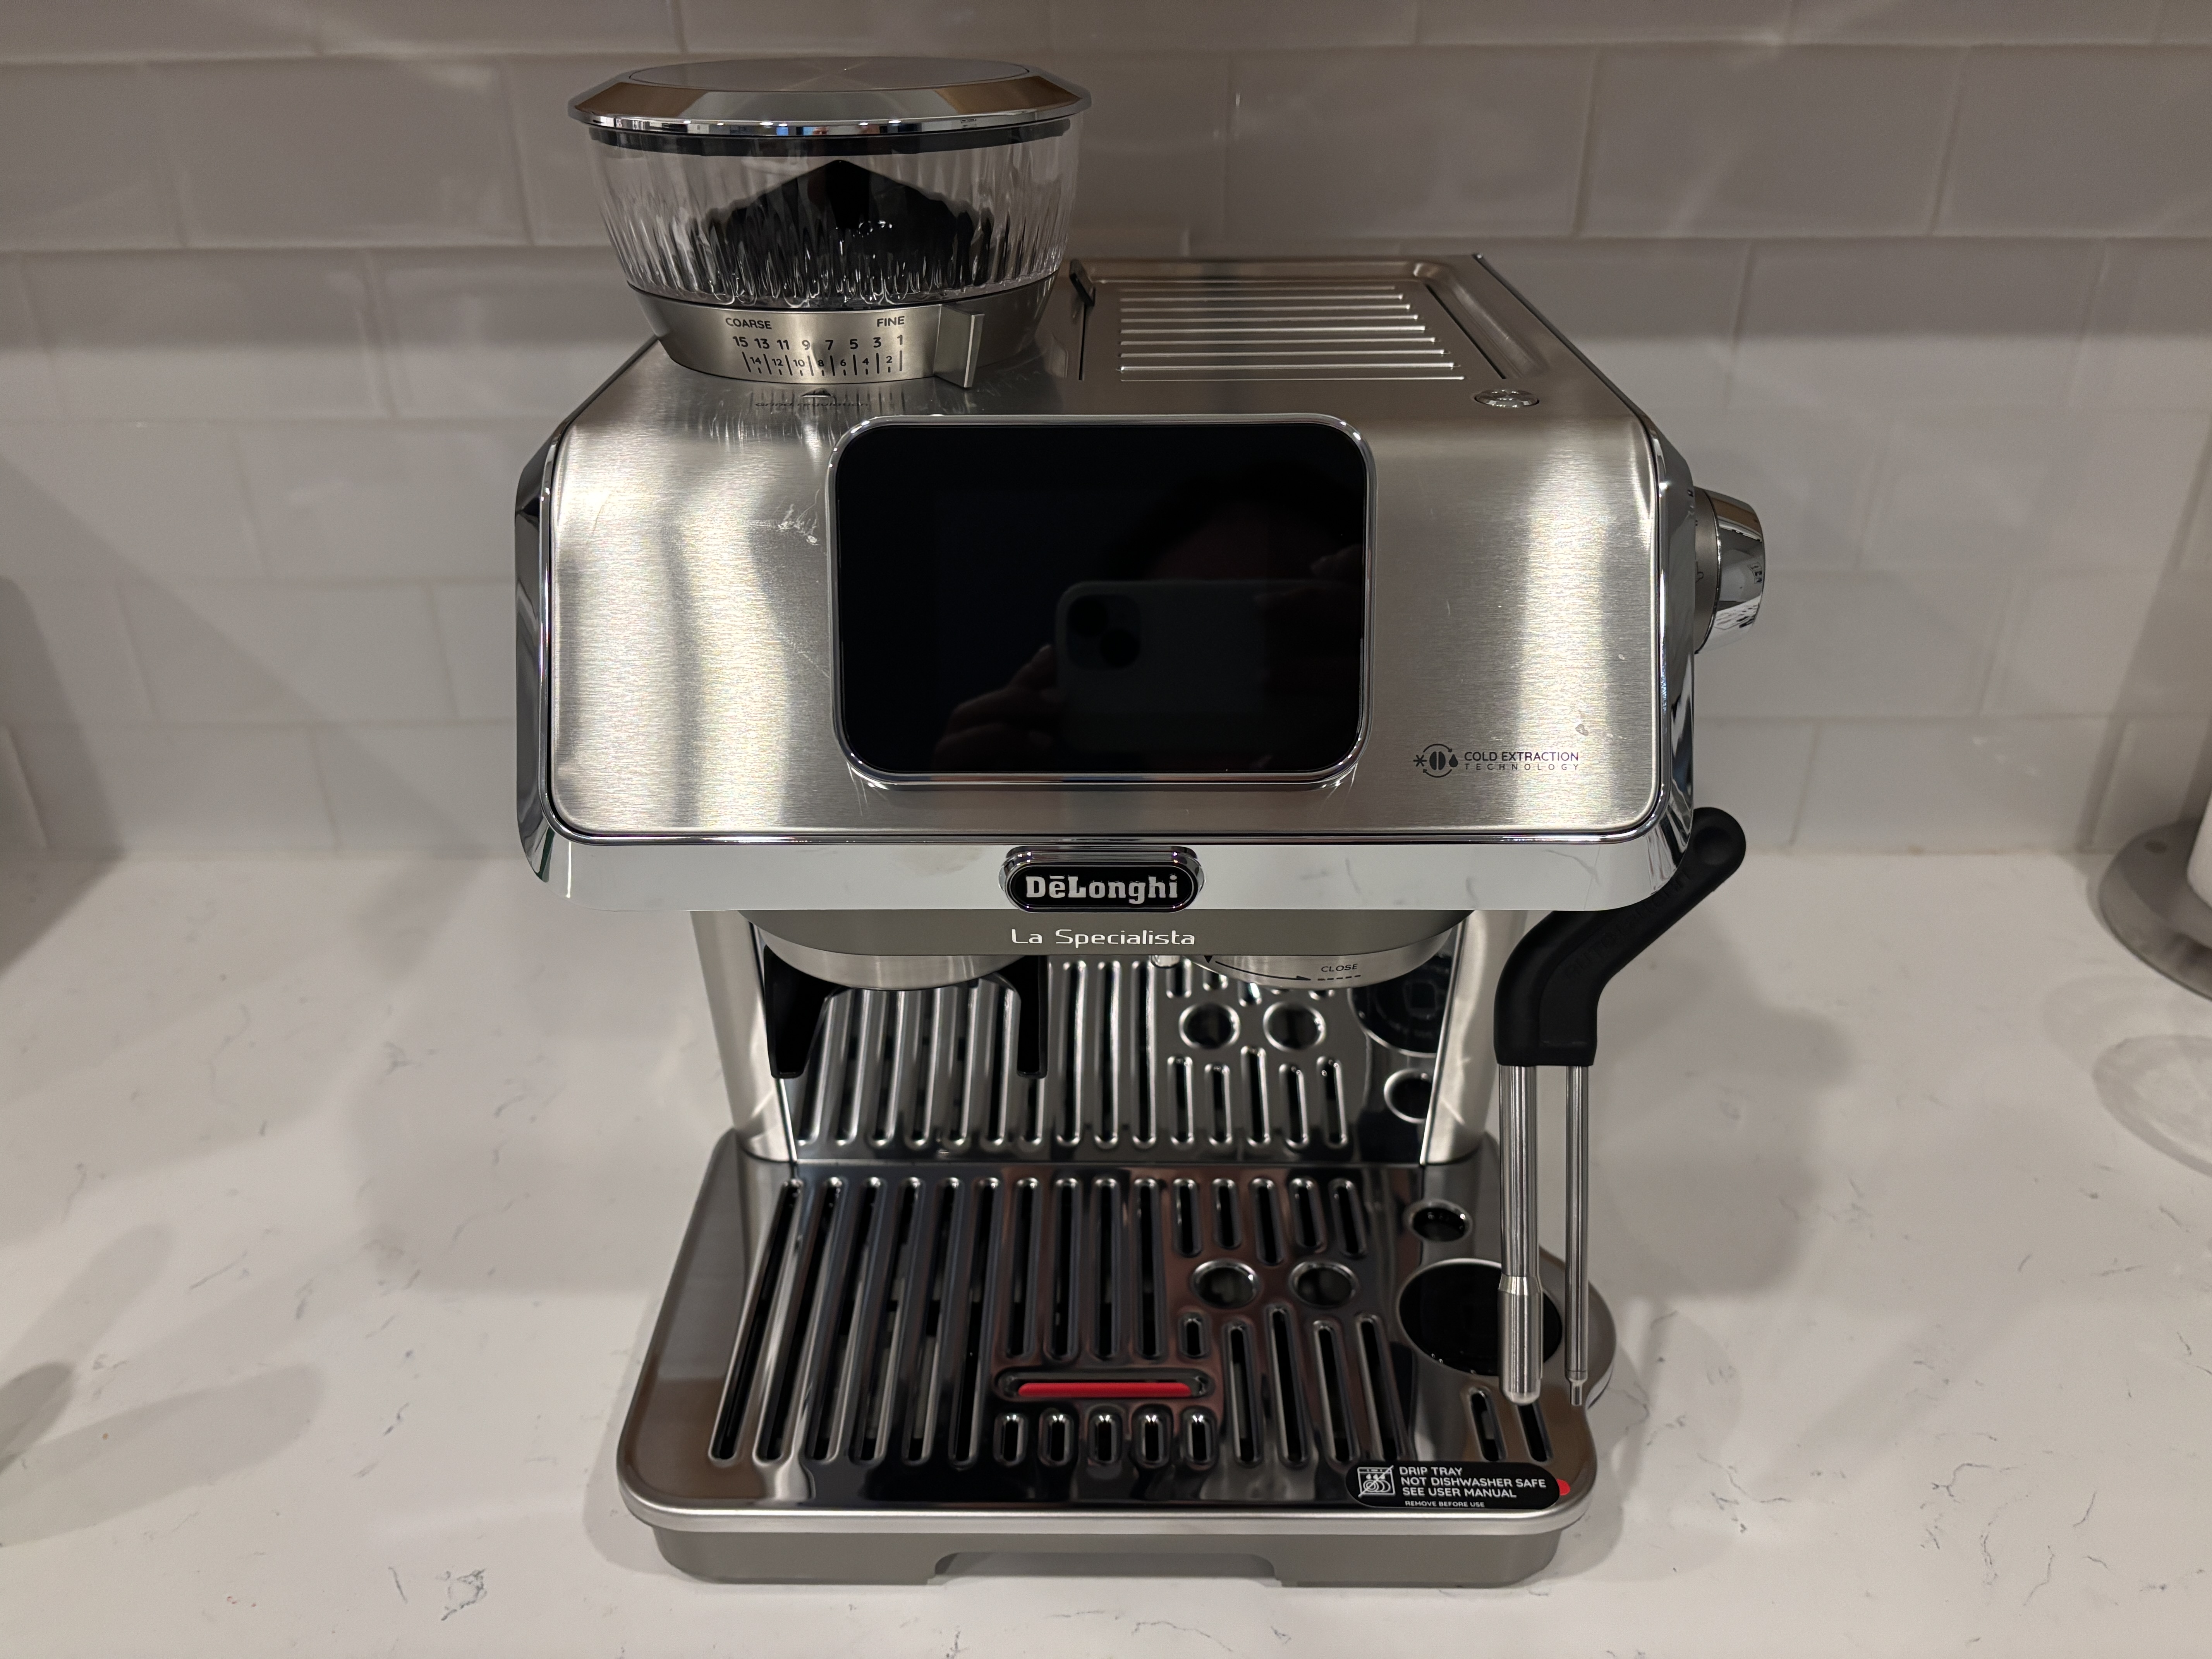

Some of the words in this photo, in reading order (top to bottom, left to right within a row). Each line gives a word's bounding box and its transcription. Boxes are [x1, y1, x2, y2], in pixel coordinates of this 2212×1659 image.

[725, 318, 772, 330] COARSE
[877, 316, 905, 327] FINE
[732, 336, 749, 347] 15
[754, 338, 770, 349] 13
[776, 339, 790, 350] 11
[802, 340, 811, 350] 9
[825, 340, 833, 350] 7
[850, 339, 859, 349] 5
[873, 337, 881, 348] 3
[897, 334, 903, 345] 1
[750, 357, 762, 365] 14
[772, 358, 784, 366] 12
[793, 359, 805, 367] 10
[1464, 751, 1498, 761] COLD
[1501, 752, 1579, 762] EXTRACTION
[1012, 929, 1042, 944] La
[1055, 929, 1195, 948] Specialista
[1321, 963, 1358, 972] CLOSE
[1399, 1467, 1428, 1476] DRIP
[1431, 1467, 1462, 1476] TRAY
[1401, 1477, 1427, 1486] NOT
[1431, 1477, 1513, 1487] DISHWASHER
[1515, 1478, 1546, 1488] SAFE
[1402, 1487, 1425, 1496] SEE
[1428, 1487, 1461, 1497] USER
[1464, 1488, 1517, 1498] MANUAL
